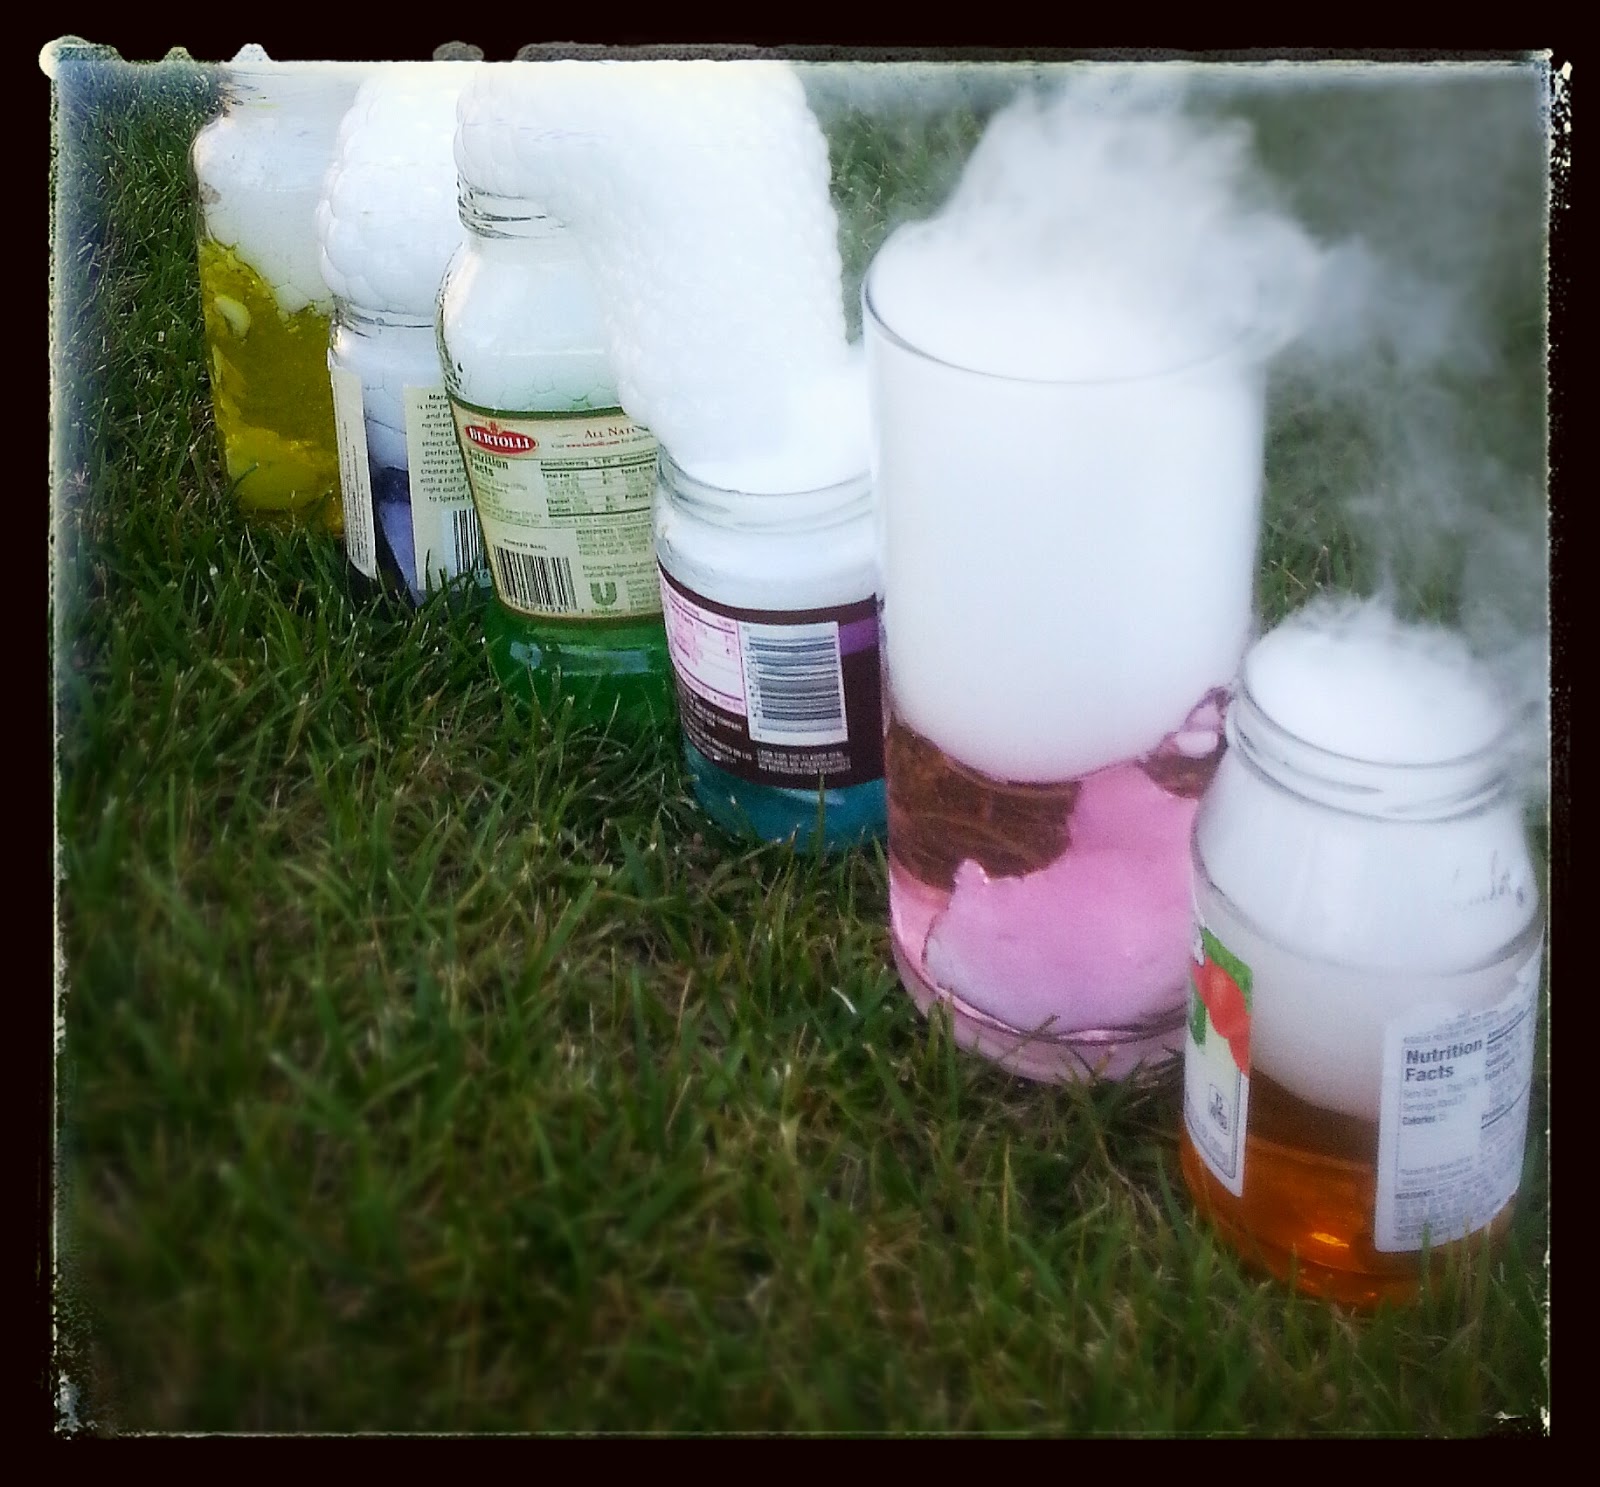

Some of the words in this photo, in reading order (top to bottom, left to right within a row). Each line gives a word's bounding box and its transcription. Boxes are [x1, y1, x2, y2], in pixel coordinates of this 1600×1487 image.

[468, 426, 531, 449] BERTOLLI
[1405, 1039, 1483, 1065] Nutrition
[1405, 1065, 1455, 1082] Facts
